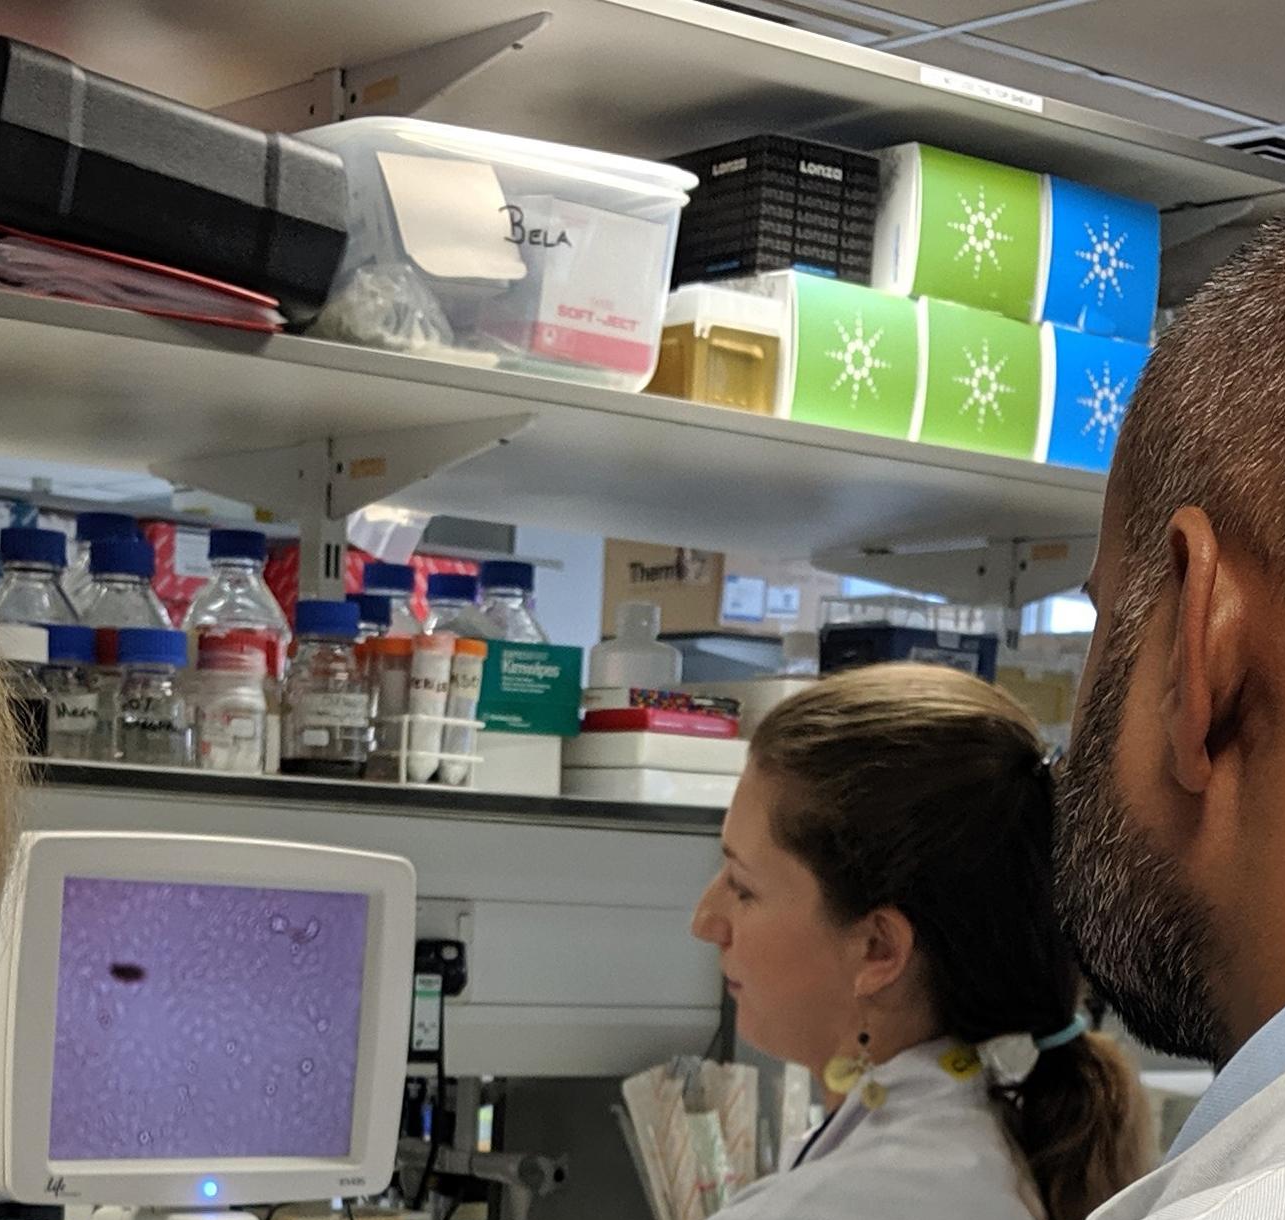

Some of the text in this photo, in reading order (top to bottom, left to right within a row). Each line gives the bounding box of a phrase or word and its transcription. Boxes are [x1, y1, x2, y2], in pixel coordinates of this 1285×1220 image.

[799, 160, 843, 181] Lonza
[629, 561, 684, 583] Therm
[501, 660, 561, 680] Kimwipes
